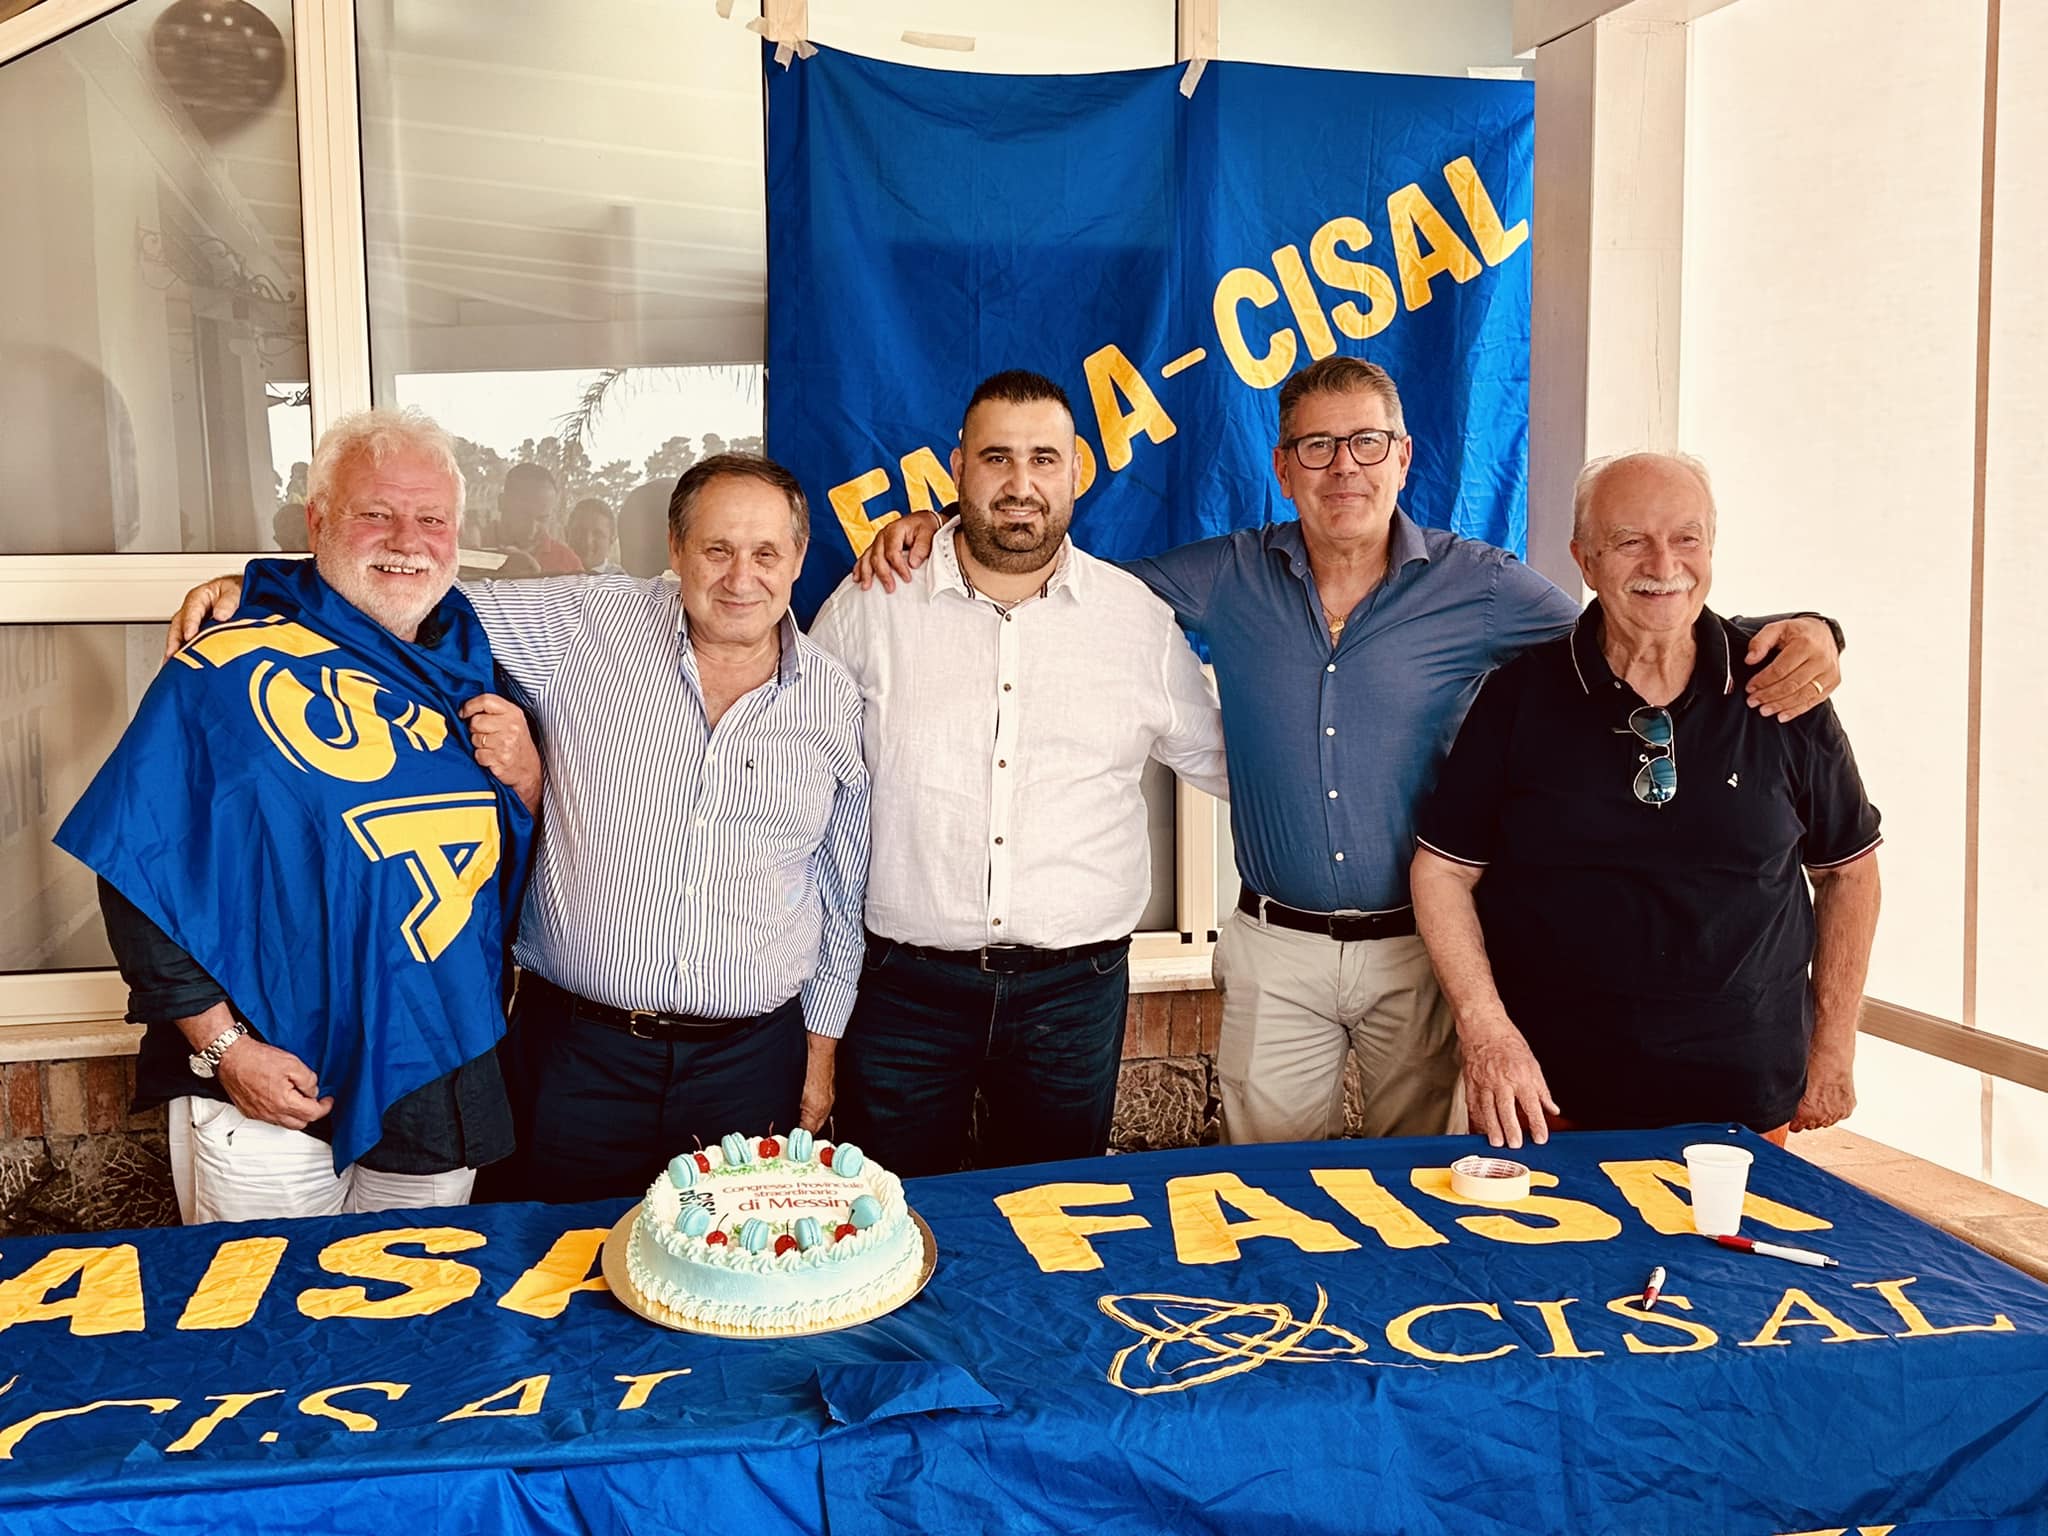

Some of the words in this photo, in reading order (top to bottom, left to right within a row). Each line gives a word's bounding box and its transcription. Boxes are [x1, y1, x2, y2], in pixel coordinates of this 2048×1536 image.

[722, 1182, 793, 1194] Congresso
[796, 1181, 865, 1190] Provinciale
[738, 1198, 761, 1212] di
[769, 1196, 851, 1210] Messin
[753, 1188, 838, 1198] straordinario
[993, 1158, 1834, 1273] FAISA
[0, 1226, 614, 1336] AISA
[1384, 1276, 2017, 1364] CISAL
